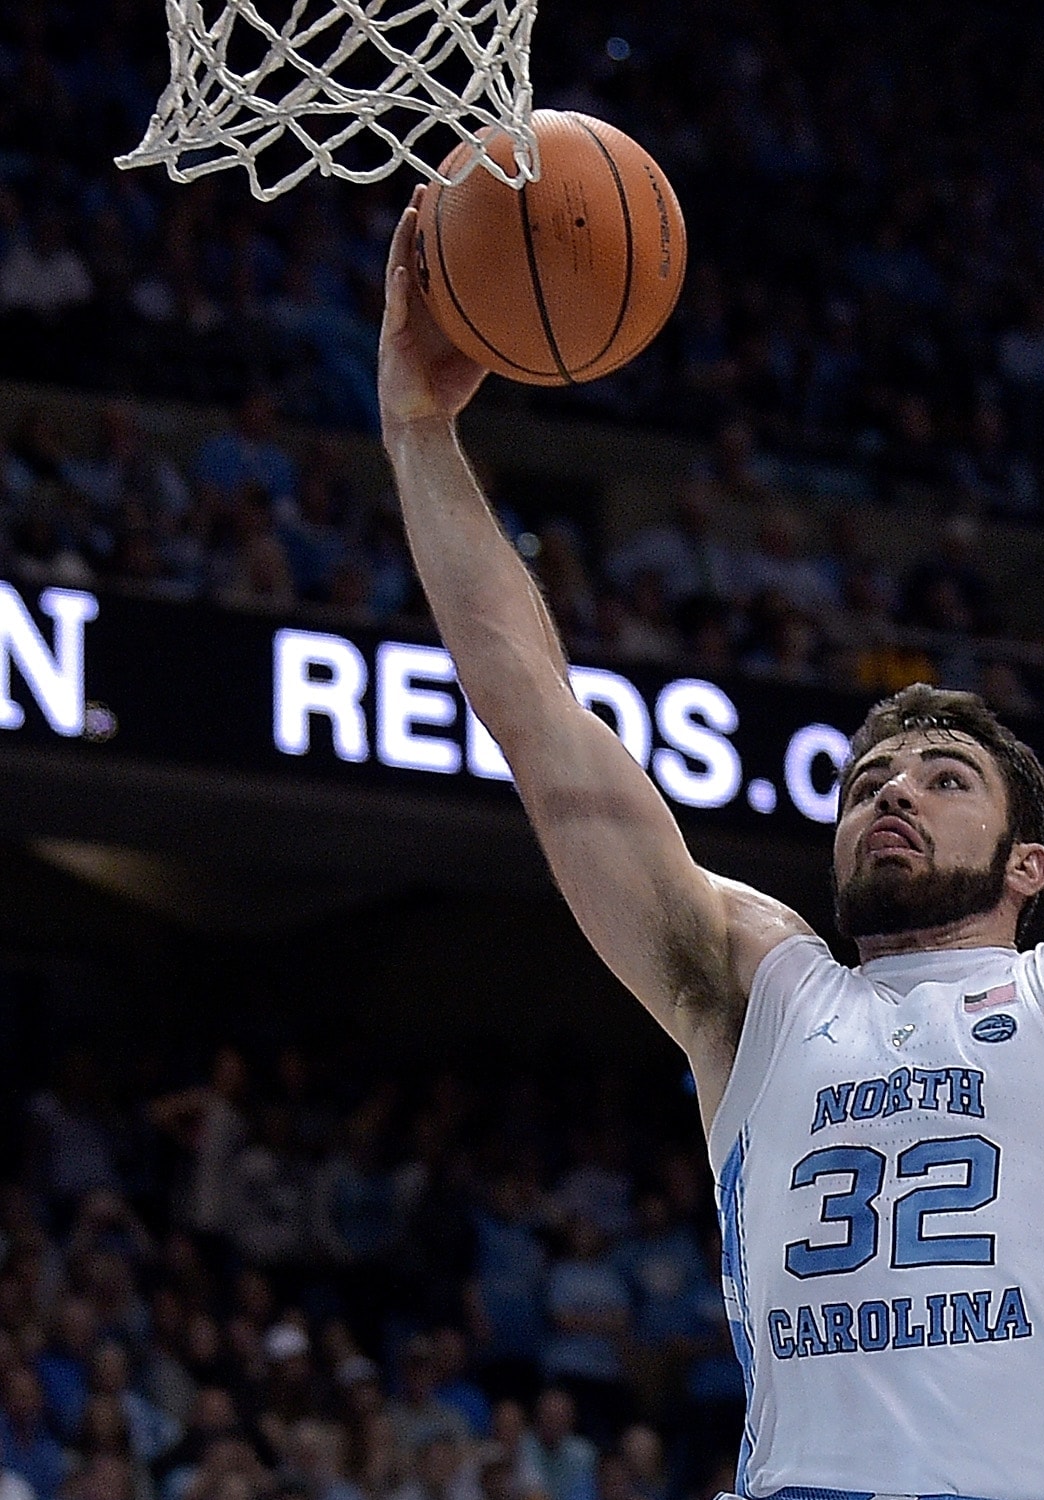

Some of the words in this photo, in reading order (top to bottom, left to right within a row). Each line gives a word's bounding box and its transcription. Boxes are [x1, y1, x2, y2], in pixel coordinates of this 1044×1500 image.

[811, 1066, 985, 1134] NORTH
[785, 1135, 1001, 1280] 32
[768, 1287, 1032, 1359] CAROLINA
